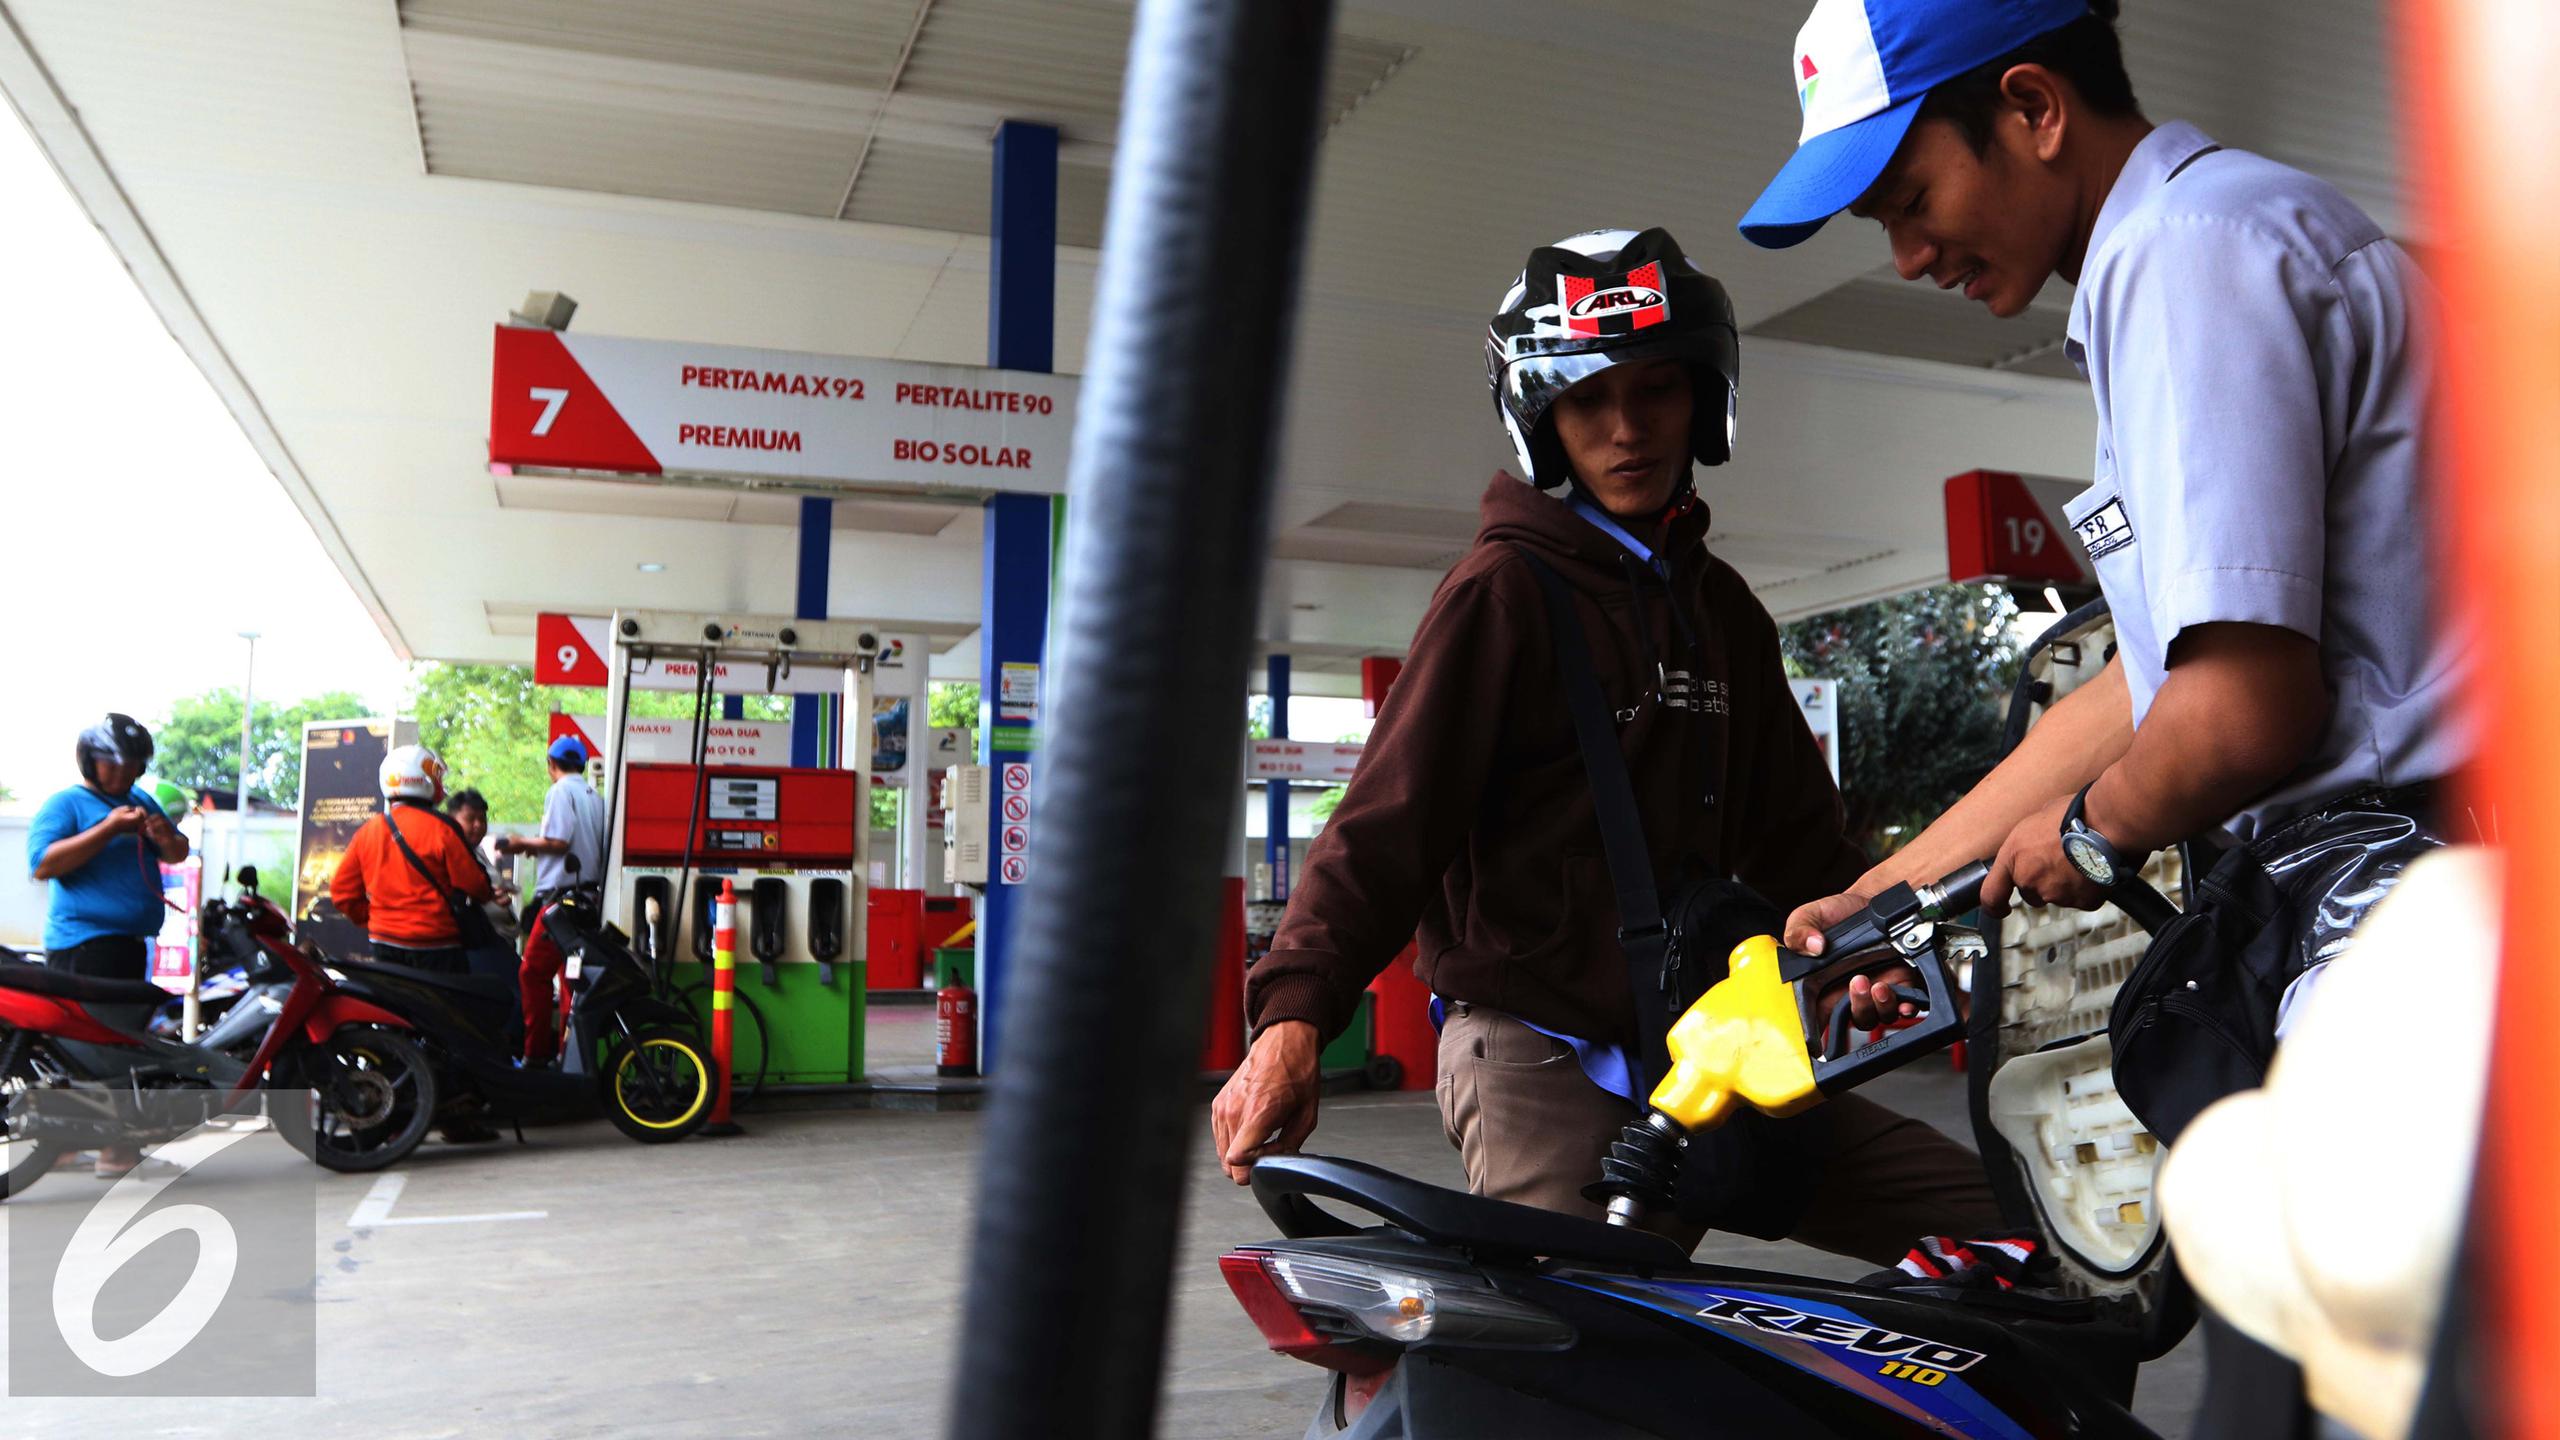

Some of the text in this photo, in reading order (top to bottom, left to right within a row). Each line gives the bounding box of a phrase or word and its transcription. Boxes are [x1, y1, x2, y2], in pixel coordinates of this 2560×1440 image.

[529, 387, 570, 436] 7
[678, 423, 802, 453] PREMIUM
[2006, 517, 2046, 556] 19
[557, 645, 579, 672] 9
[665, 662, 728, 677] PREMM
[628, 724, 674, 735] AMAX92
[1696, 1293, 1988, 1373] REVO
[1877, 1360, 1949, 1387] 110
